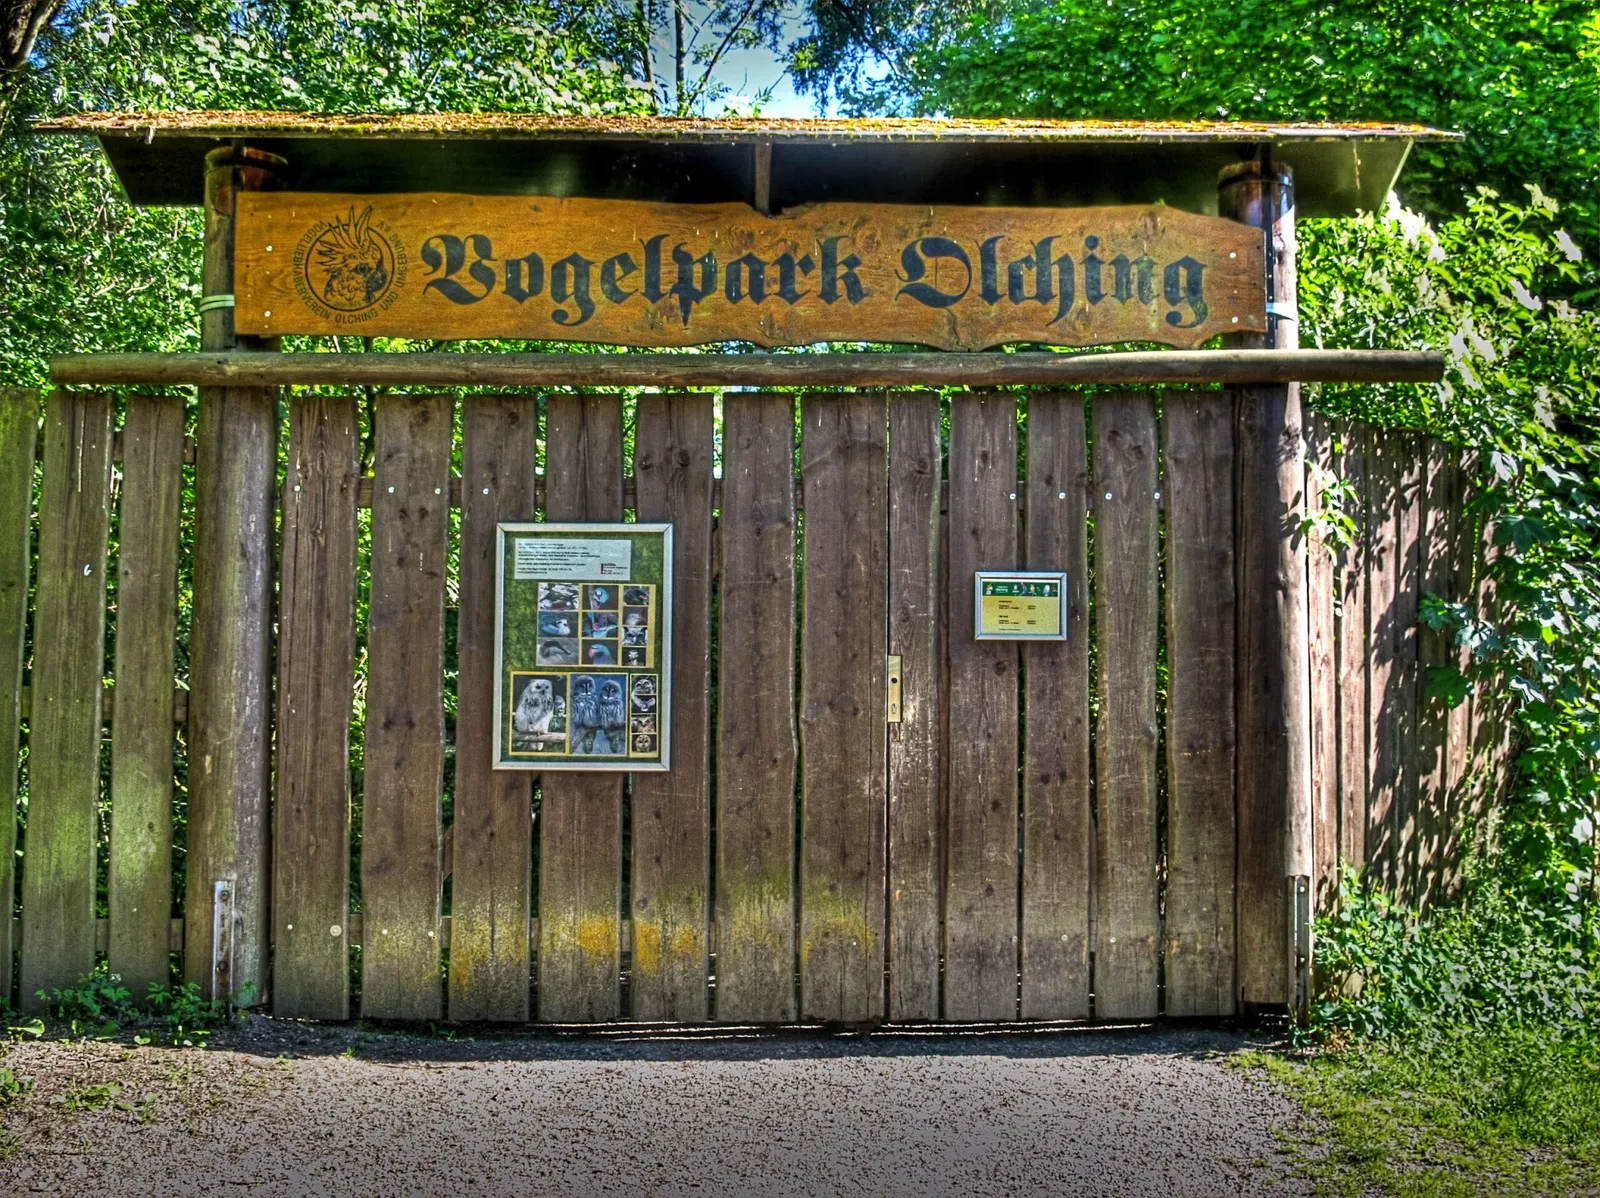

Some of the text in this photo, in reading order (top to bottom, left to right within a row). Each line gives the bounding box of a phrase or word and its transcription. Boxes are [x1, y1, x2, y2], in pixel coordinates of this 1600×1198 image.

[293, 221, 330, 320] VOGELLIEBHABERVEREIN
[334, 308, 378, 324] OLCHING
[379, 291, 398, 310] UND
[390, 233, 407, 288] UMGEBUNG
[420, 233, 1208, 328] Vogelpark Olching
